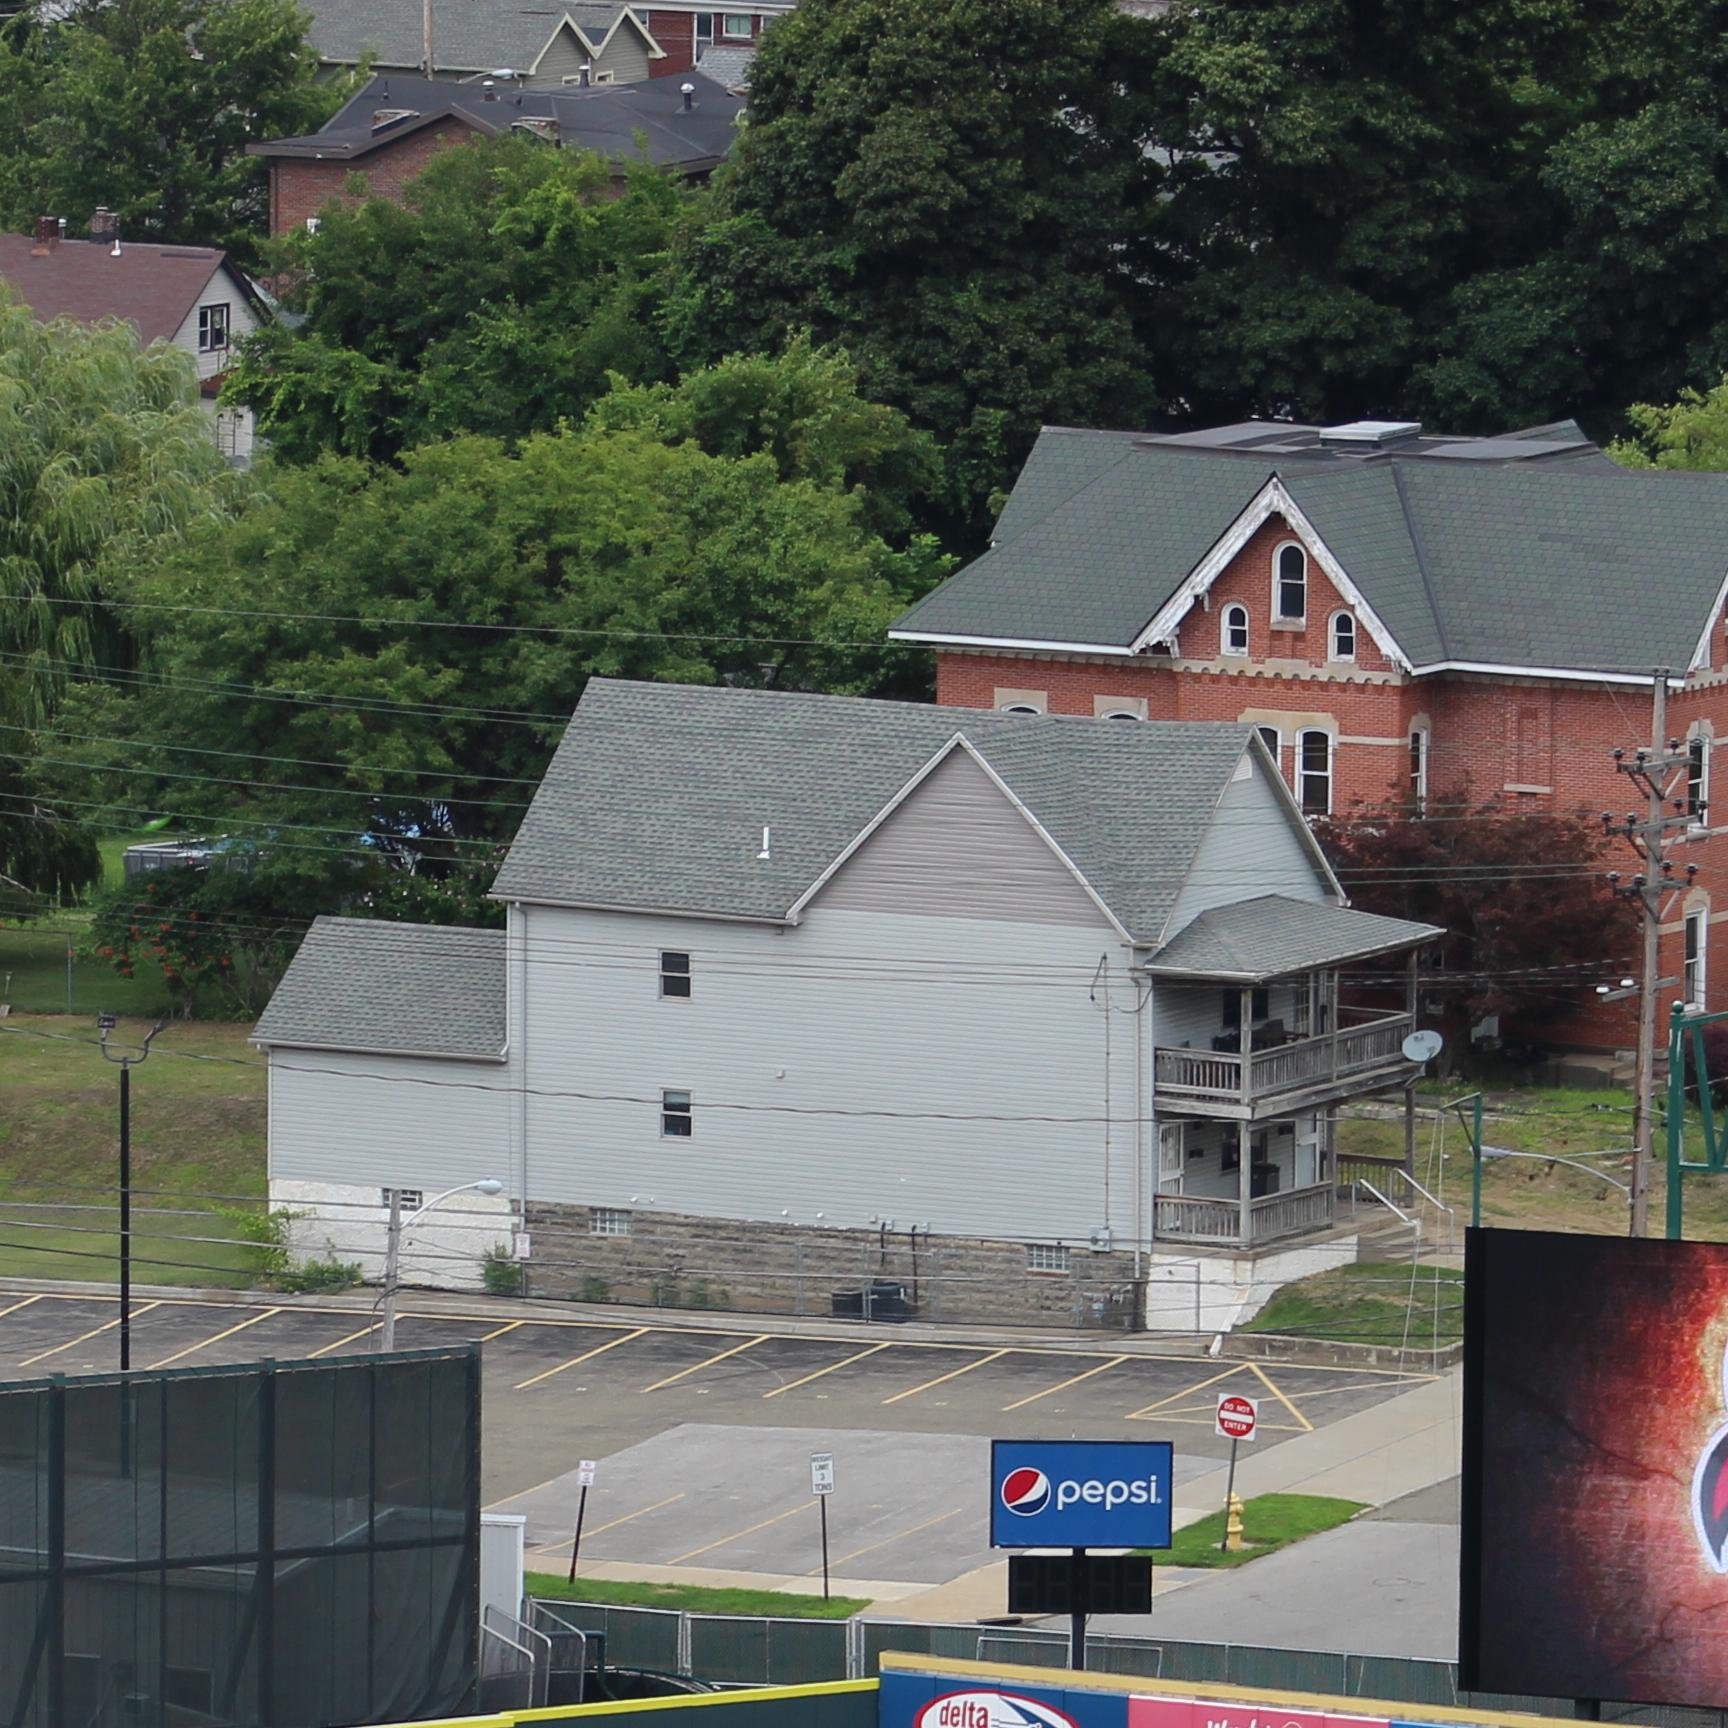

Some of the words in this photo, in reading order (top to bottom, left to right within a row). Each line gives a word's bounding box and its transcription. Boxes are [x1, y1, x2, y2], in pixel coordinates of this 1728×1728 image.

[1224, 1402, 1234, 1411] DO
[1236, 1405, 1250, 1414] NOT
[1224, 1421, 1248, 1430] ENTER
[1057, 1475, 1157, 1510] pepsi
